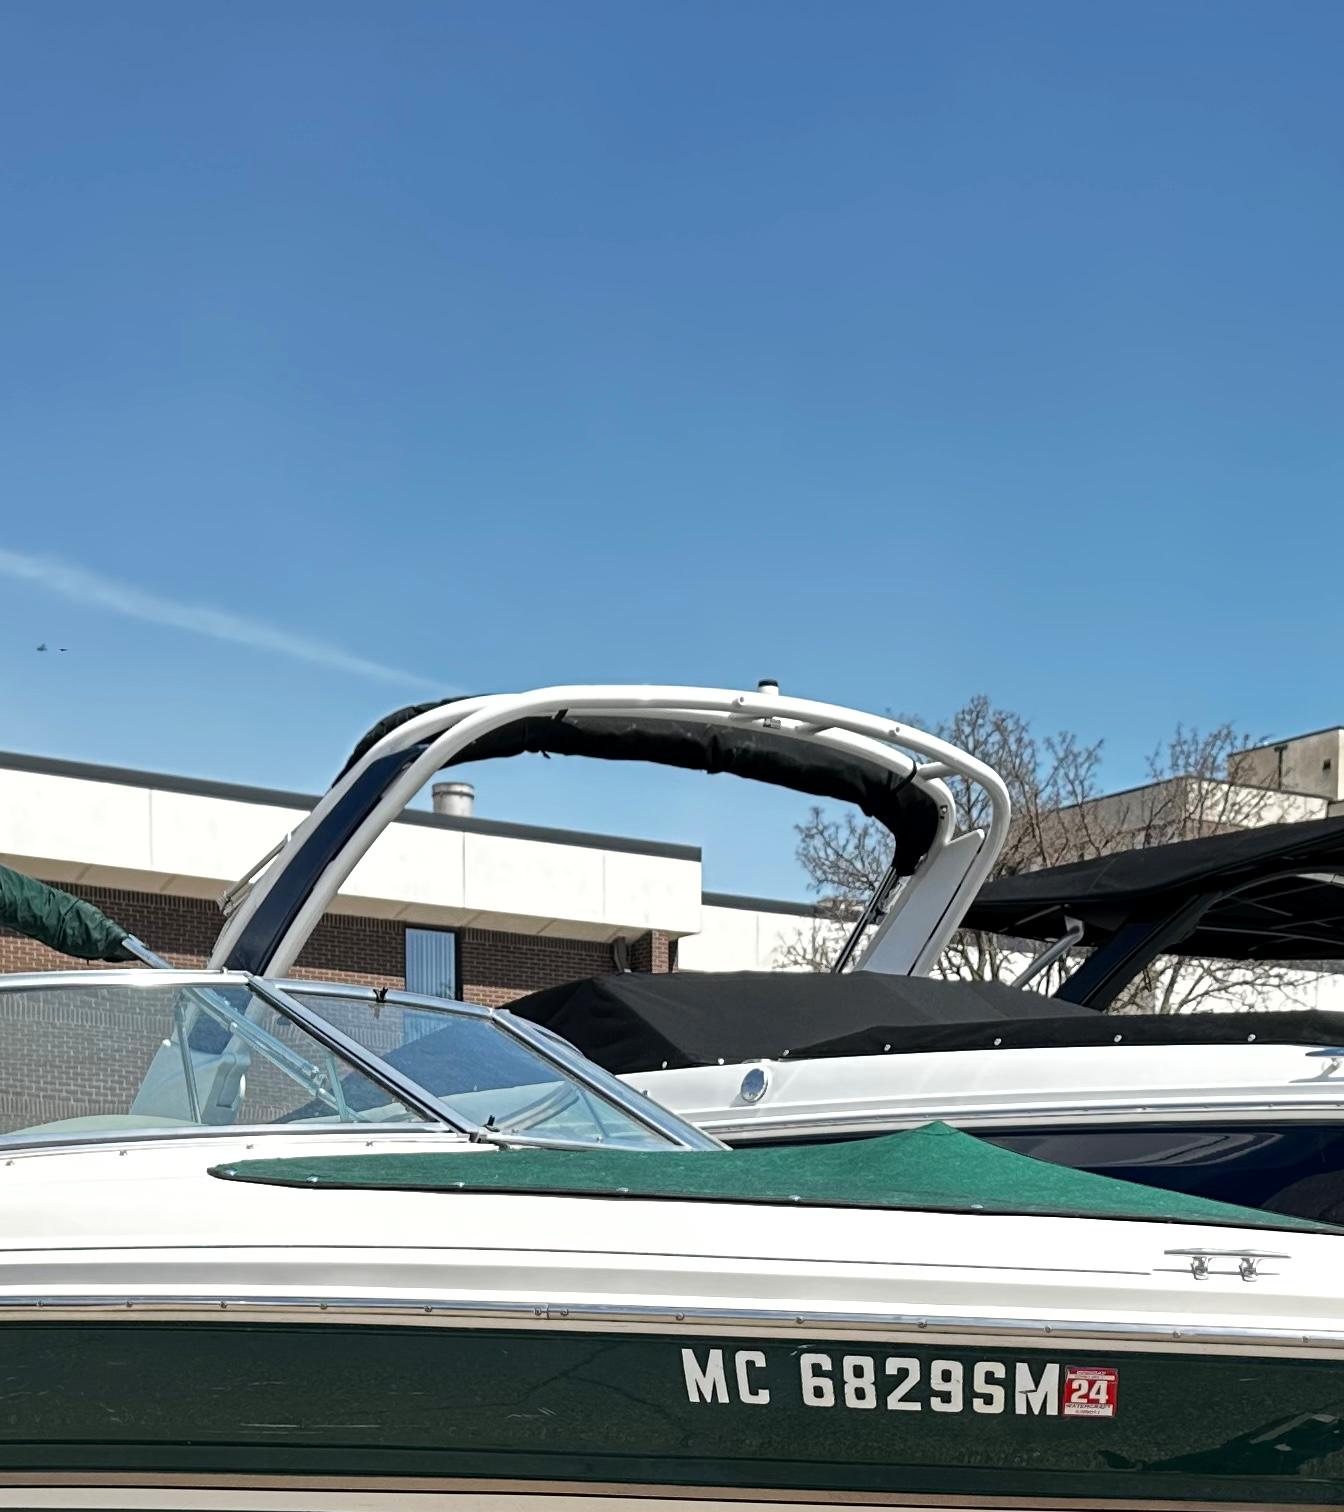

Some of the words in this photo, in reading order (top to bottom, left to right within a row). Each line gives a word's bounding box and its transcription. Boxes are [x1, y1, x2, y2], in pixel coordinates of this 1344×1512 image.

[681, 1348, 770, 1405] MC
[800, 1353, 1060, 1416] 6829SM
[1071, 1379, 1108, 1404] 24
